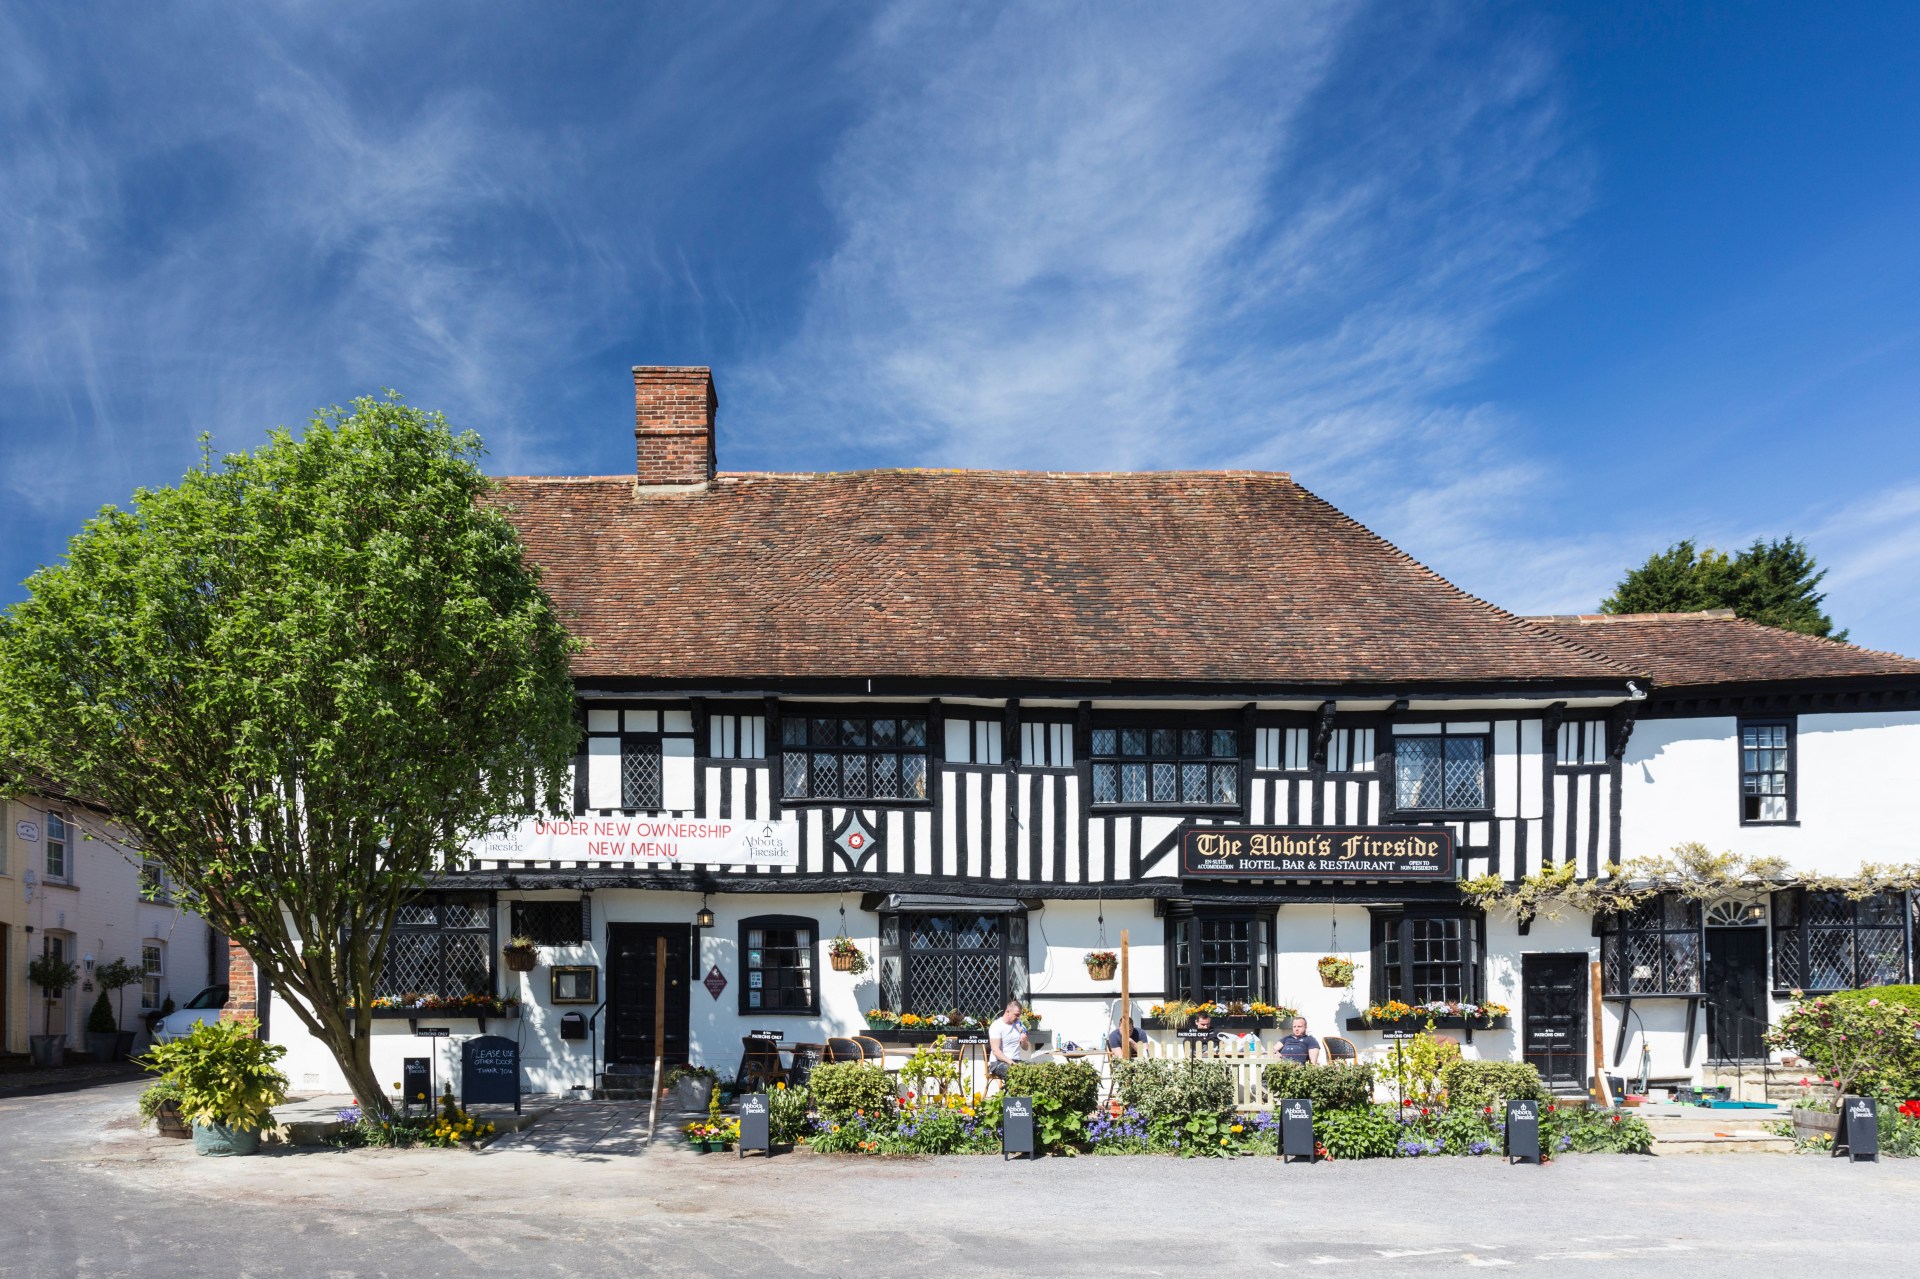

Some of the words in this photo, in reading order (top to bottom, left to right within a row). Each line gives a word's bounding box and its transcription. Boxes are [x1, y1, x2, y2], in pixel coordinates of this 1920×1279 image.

[535, 822, 589, 836] UNDER
[594, 823, 631, 836] NEW
[637, 824, 732, 839] OWNERSHIP
[742, 836, 783, 847] Abbot's
[1196, 834, 1242, 859] The
[1250, 834, 1332, 856] Abbot's
[1338, 835, 1439, 860] Fireside
[588, 842, 625, 855] NEW
[631, 843, 678, 856] MENU
[750, 847, 789, 859] Fireside
[1239, 859, 1281, 871] HOTEL,
[1282, 859, 1305, 870] BAR
[1307, 860, 1317, 870] &
[1319, 860, 1395, 871] RESTAURANT
[472, 1048, 500, 1058] PLEASE
